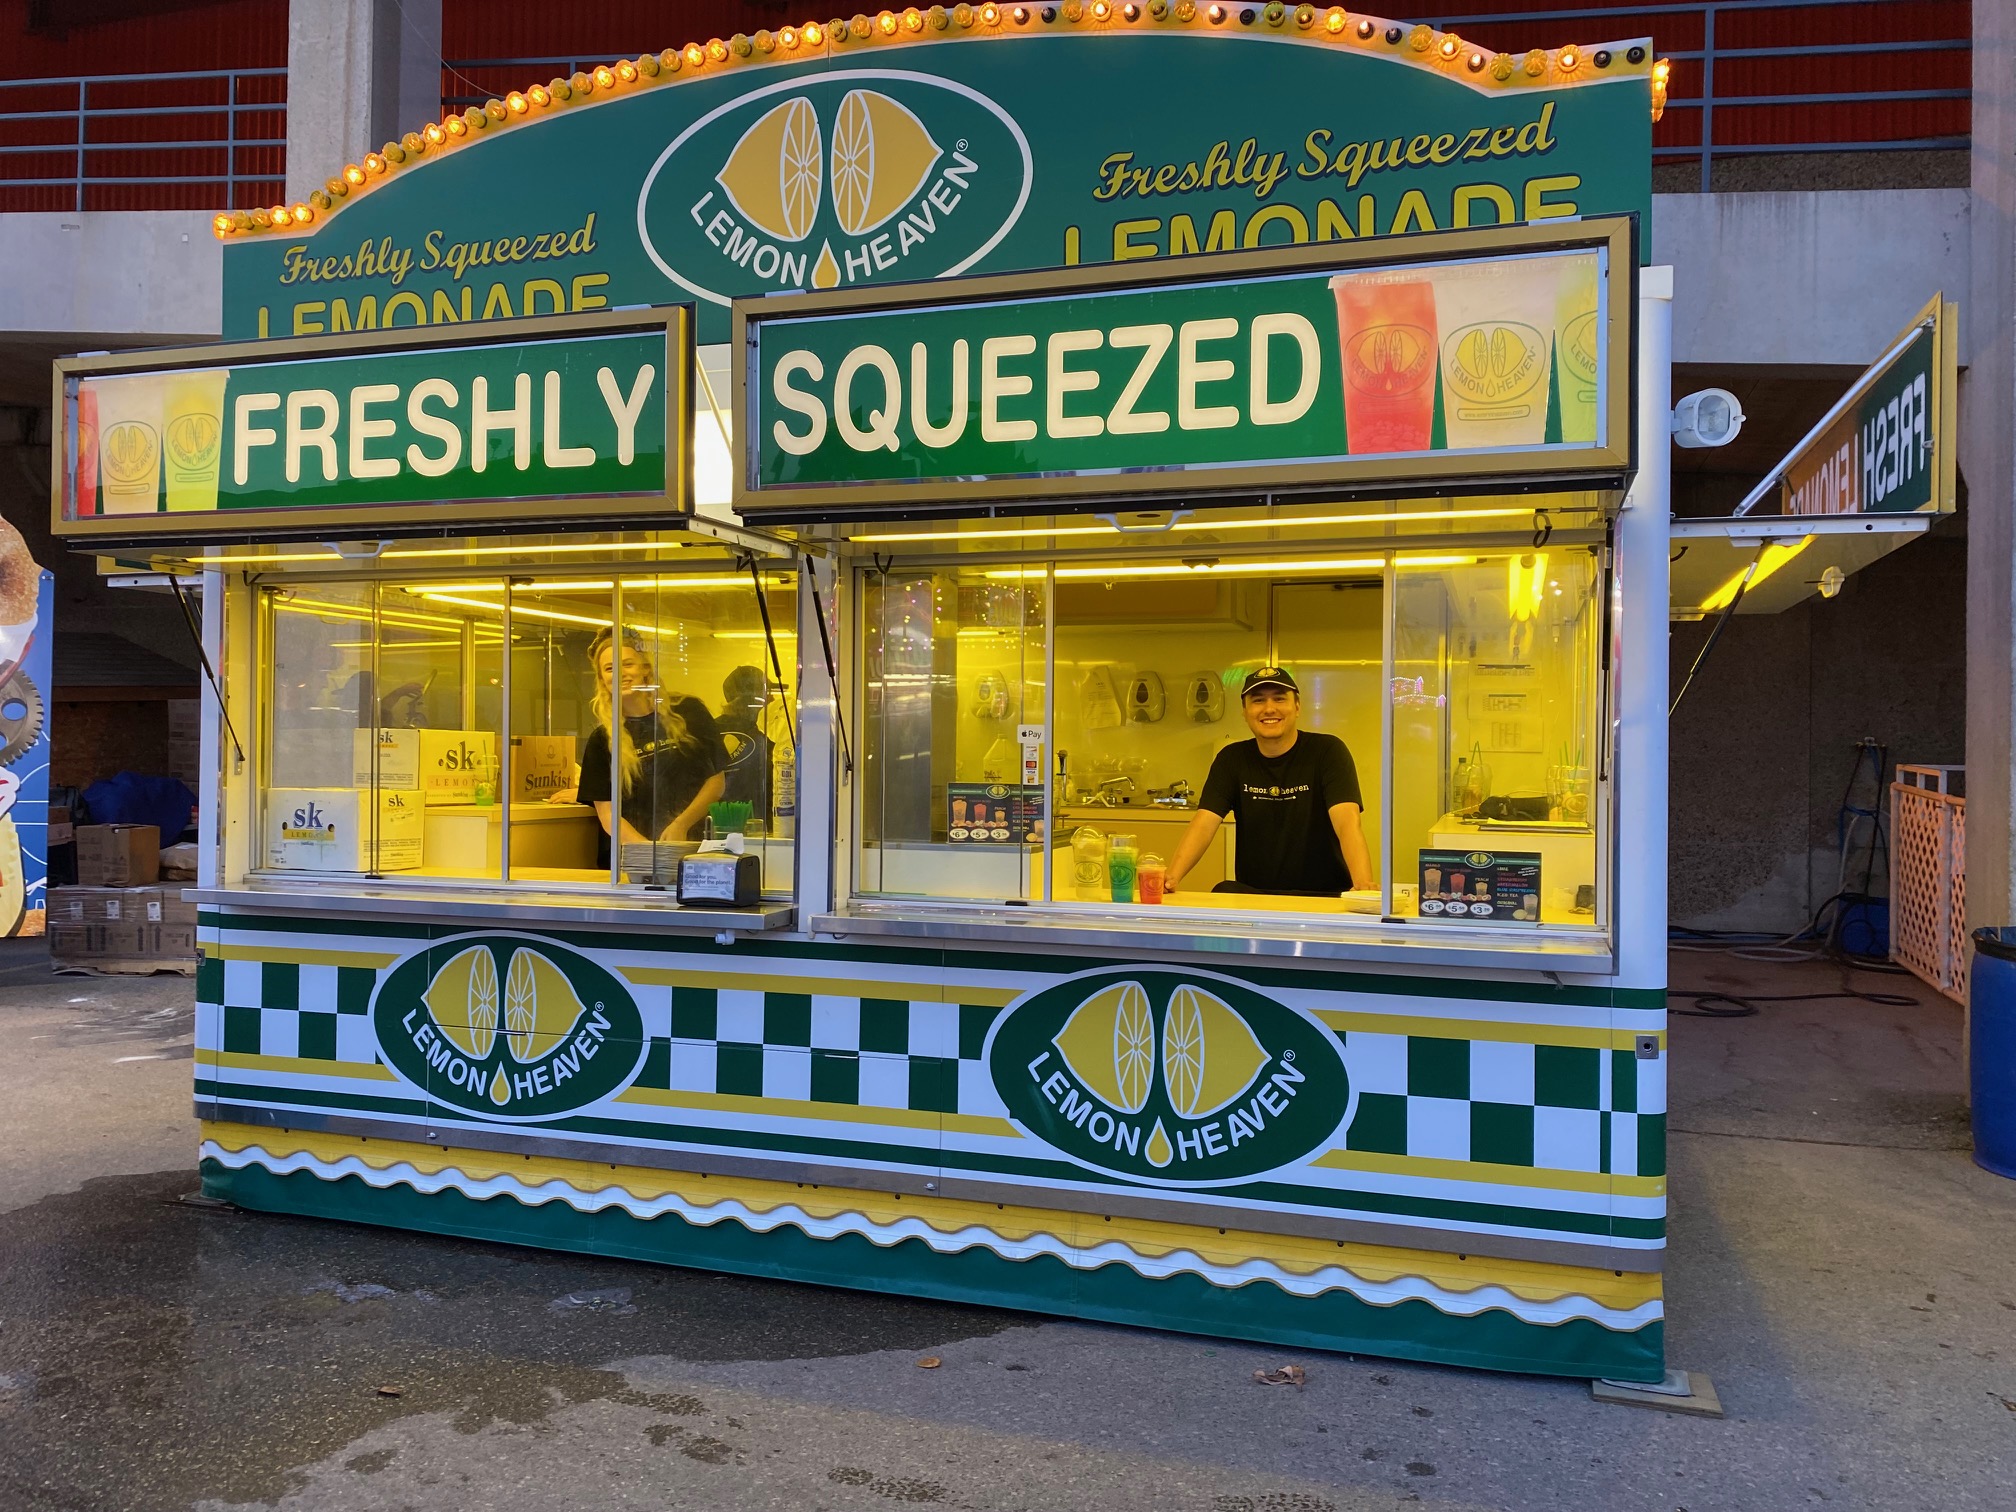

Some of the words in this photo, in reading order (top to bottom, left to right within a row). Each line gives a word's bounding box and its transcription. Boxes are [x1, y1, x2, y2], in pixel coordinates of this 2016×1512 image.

[1093, 137, 1289, 199] Freshly
[1297, 102, 1557, 188] Squeezed
[279, 235, 415, 285] Freshly
[419, 212, 598, 280] Squeezed
[690, 191, 807, 287] LEMON
[772, 312, 1322, 456] SQUEEZED
[1450, 359, 1484, 395] LEMON
[1570, 343, 1598, 375] LEMO
[233, 363, 656, 486] FRESHLY
[446, 740, 476, 771] sk
[1028, 730, 1042, 739] Pay
[388, 794, 405, 808] sk
[524, 770, 572, 791] Sunkist
[293, 801, 323, 829] sk
[402, 1008, 488, 1097] LEMON
[1027, 1050, 1141, 1157] LEMON
